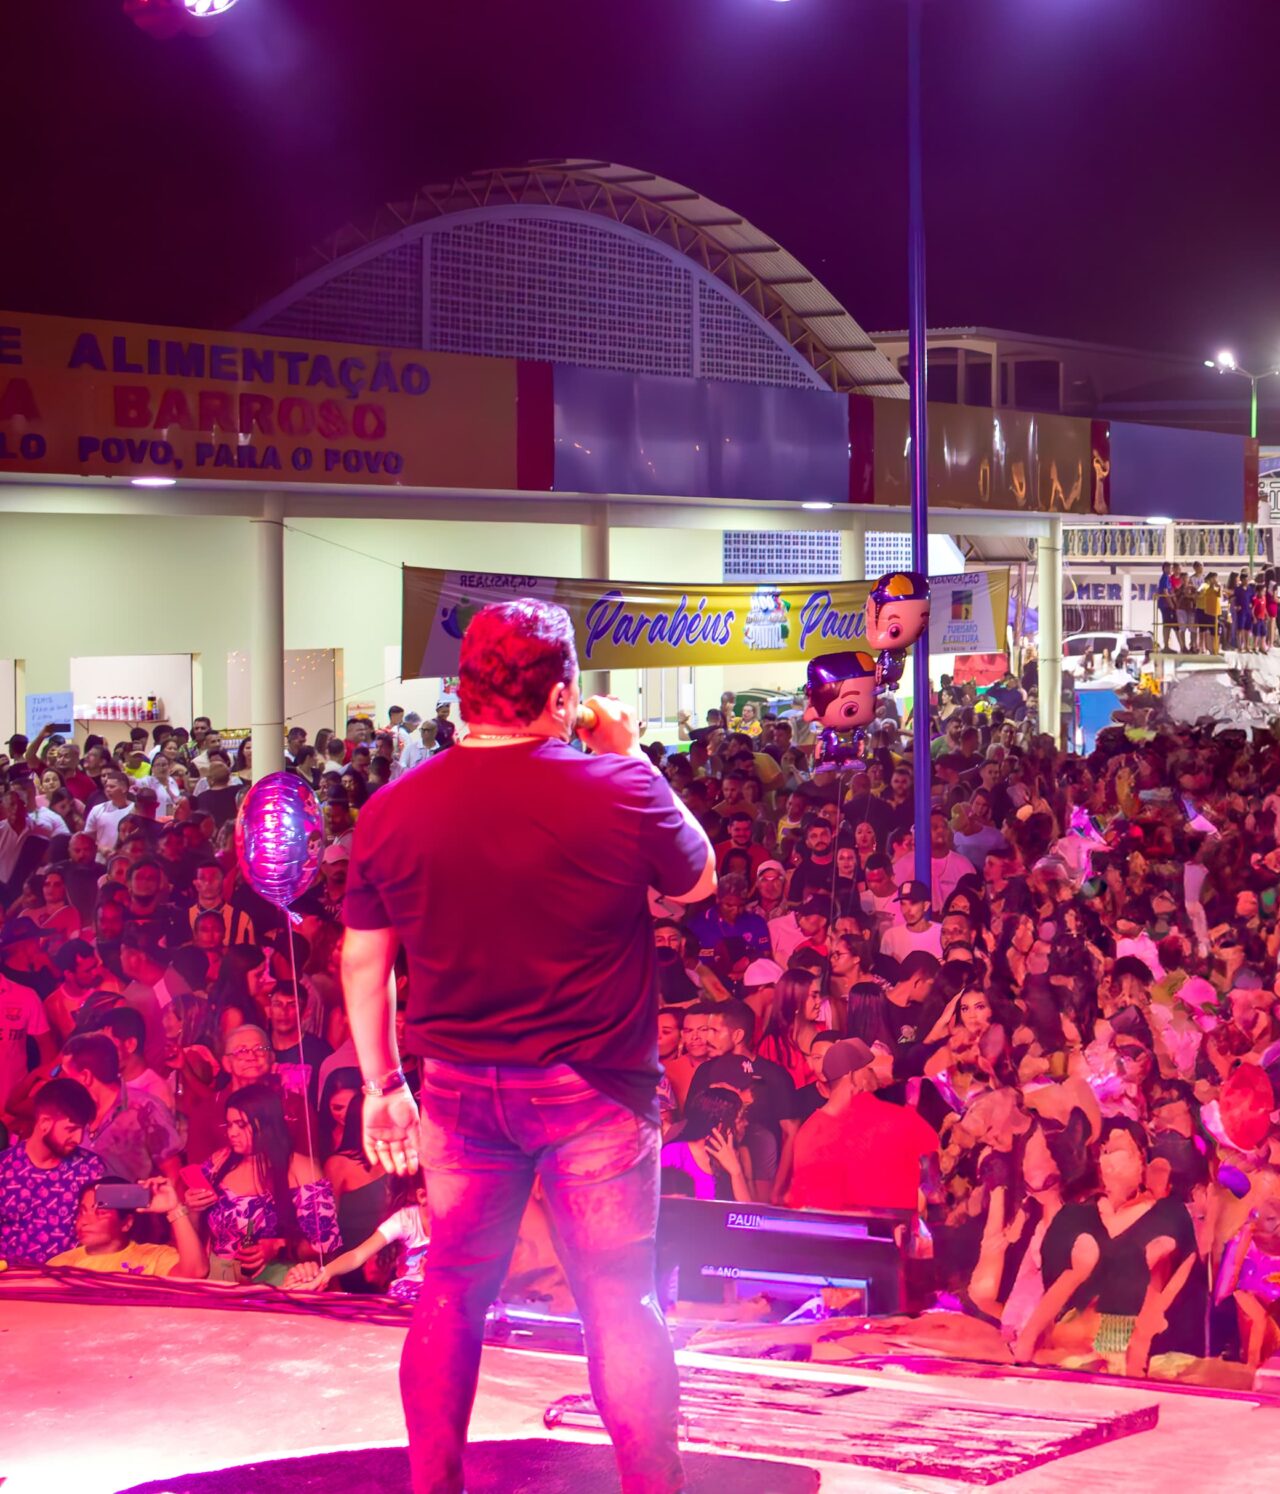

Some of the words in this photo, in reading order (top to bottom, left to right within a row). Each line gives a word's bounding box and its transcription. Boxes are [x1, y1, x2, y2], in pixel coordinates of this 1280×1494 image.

[67, 332, 431, 400] ALIMENTAÇÃO
[113, 384, 387, 441] BARROSO
[78, 436, 183, 471] POVO,
[195, 442, 282, 471] PARA
[291, 446, 313, 472] O
[324, 447, 404, 475] POVO
[585, 590, 735, 659] Parabéns
